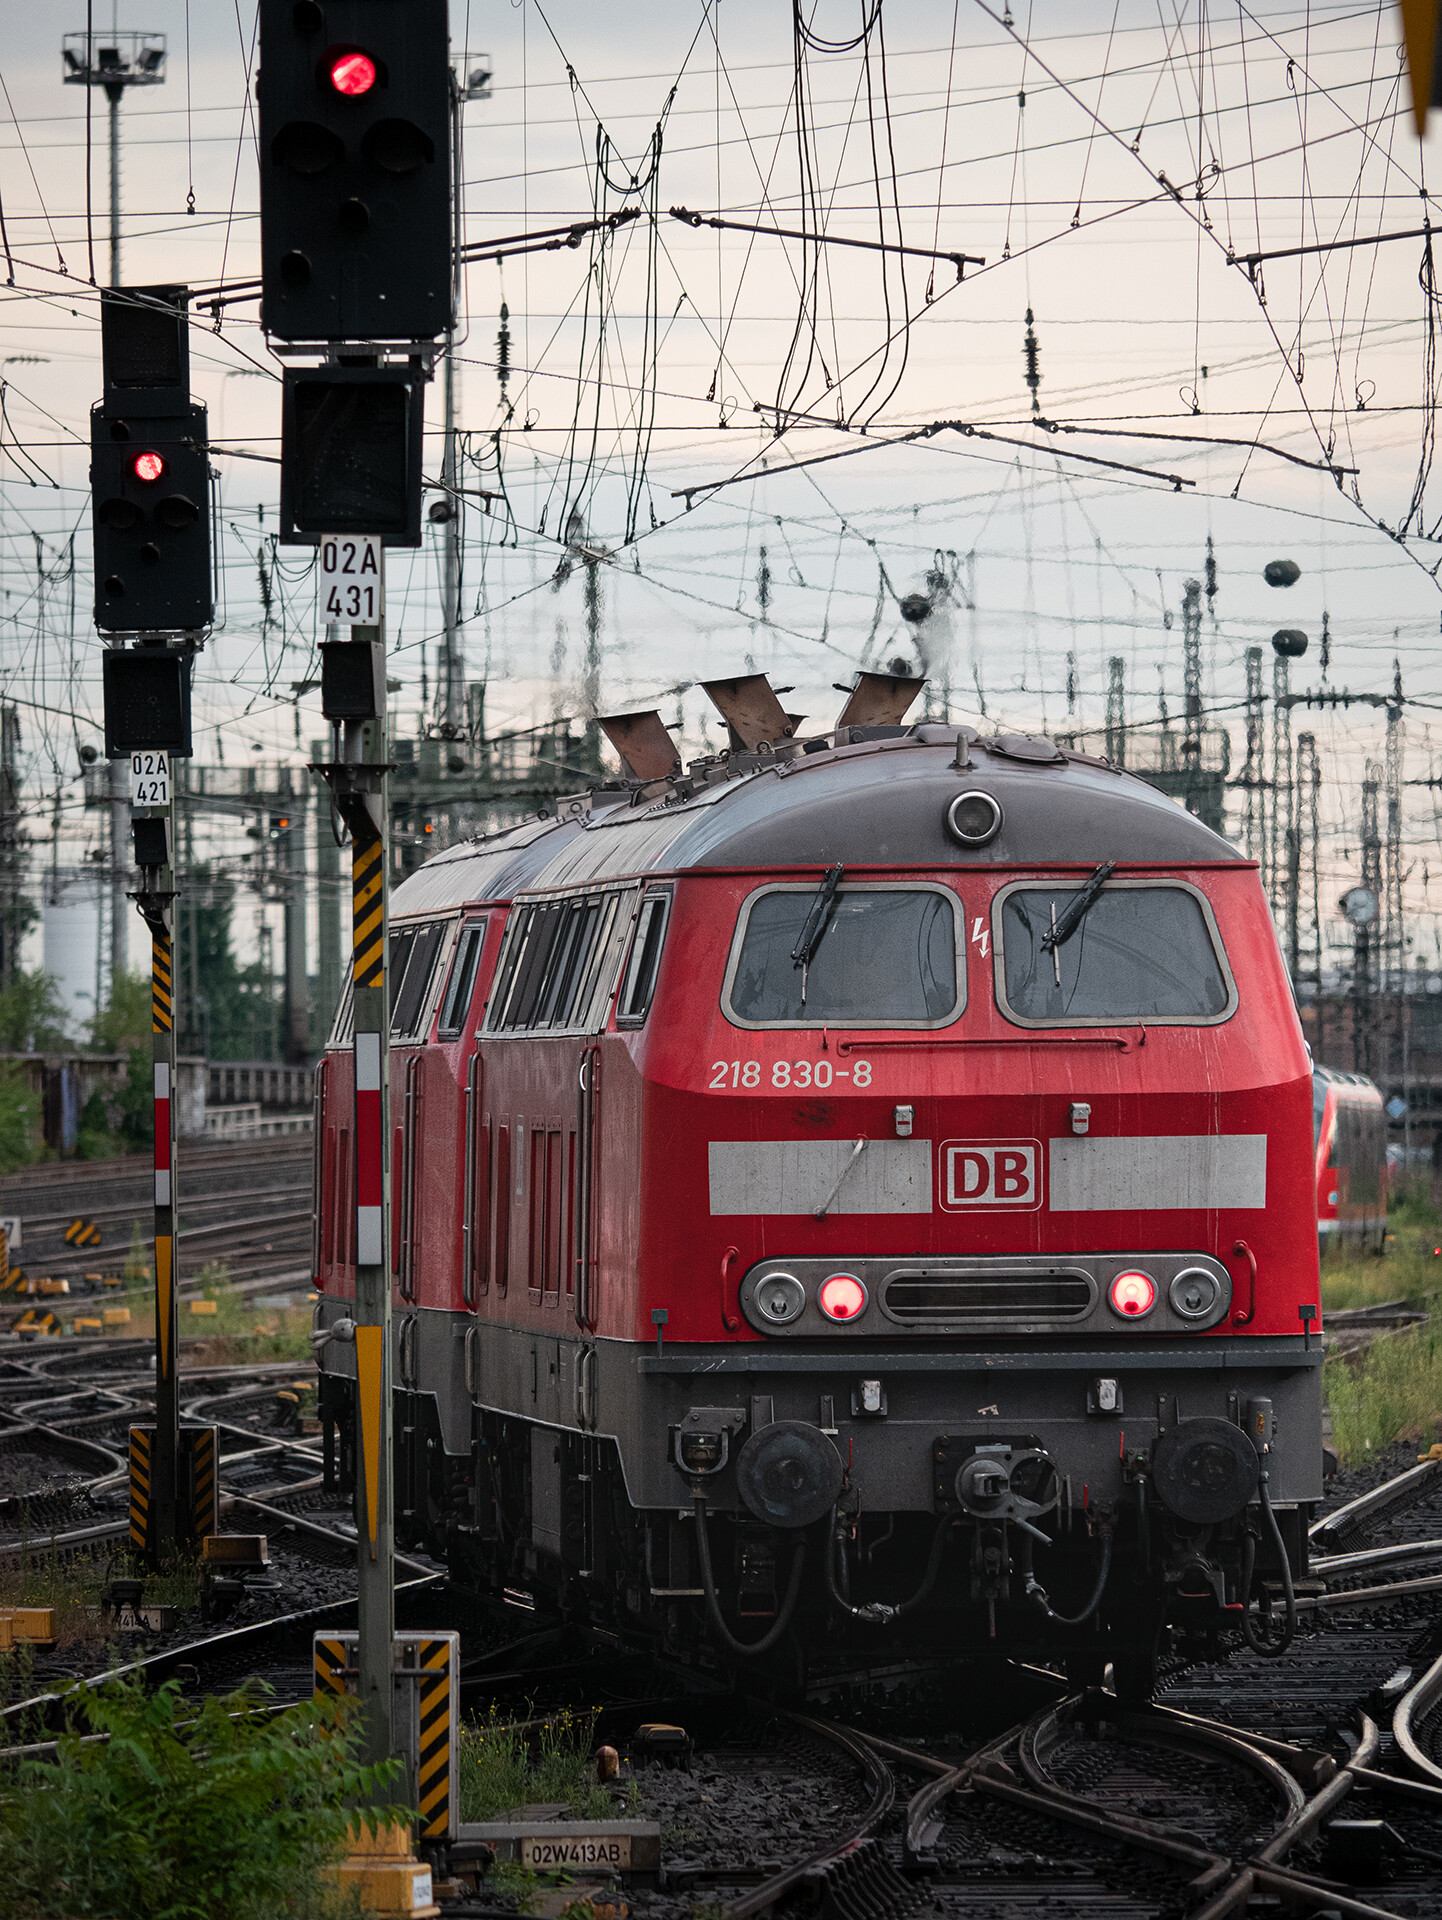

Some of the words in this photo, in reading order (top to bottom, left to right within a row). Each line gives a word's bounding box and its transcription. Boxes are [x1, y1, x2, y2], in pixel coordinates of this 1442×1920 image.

[323, 542, 378, 575] 02A
[326, 585, 374, 618] 431
[133, 754, 168, 775] 02A
[137, 781, 167, 802] 421
[708, 1060, 761, 1089] 218
[771, 1060, 873, 1088] 830-8
[953, 1151, 1030, 1199] DB
[532, 1844, 620, 1864] 02W413AB
